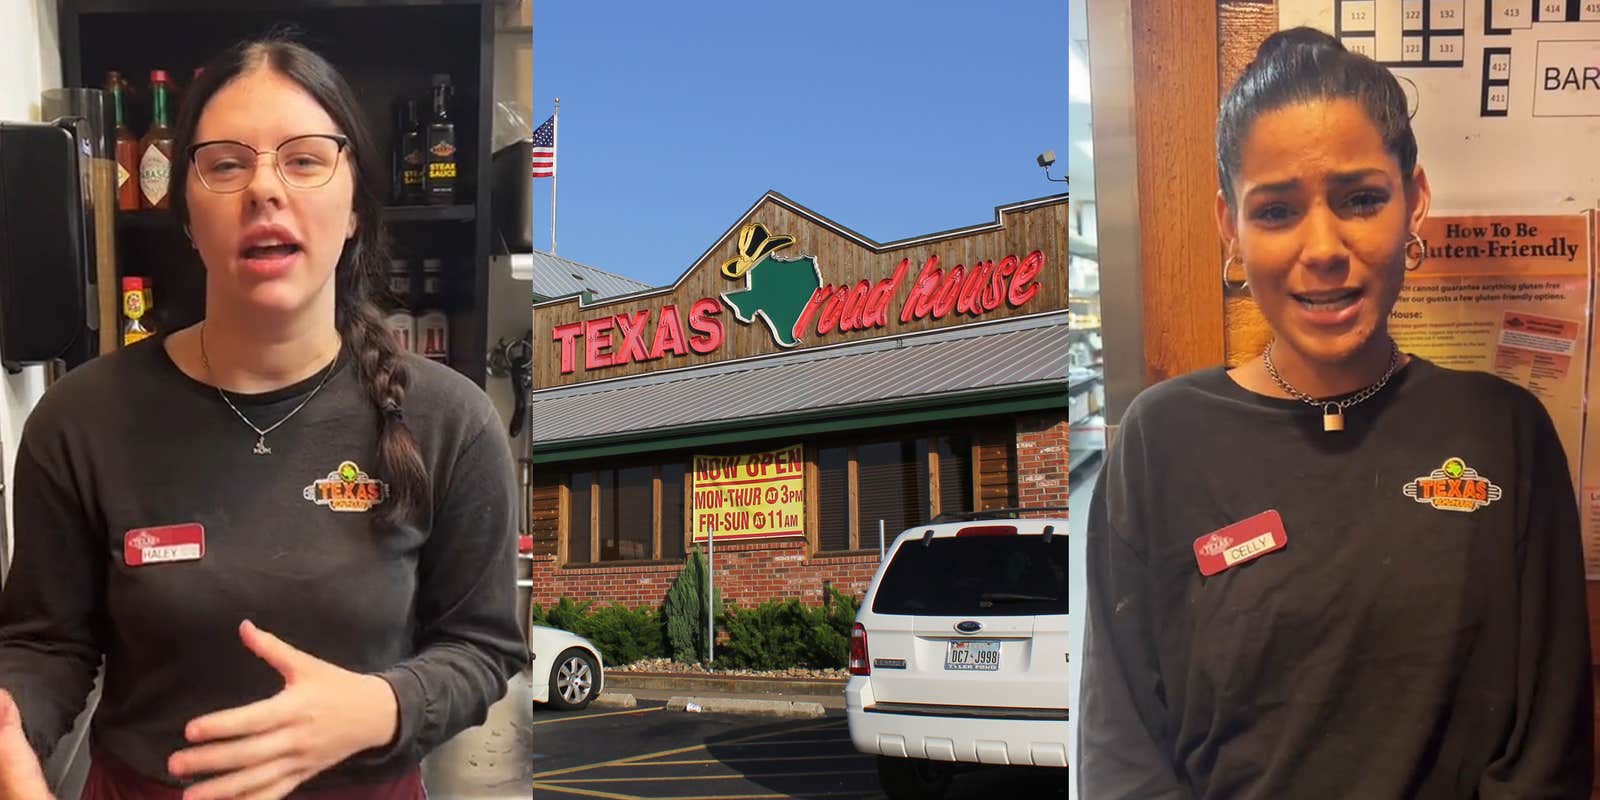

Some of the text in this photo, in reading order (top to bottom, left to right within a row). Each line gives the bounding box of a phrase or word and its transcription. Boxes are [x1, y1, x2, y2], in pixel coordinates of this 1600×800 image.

[1440, 10, 1455, 18] 132
[1504, 8, 1520, 17] 413
[1545, 5, 1560, 13] 414
[1351, 11, 1366, 20] 112
[1406, 11, 1420, 19] 122
[1405, 45, 1420, 53] 121
[1440, 44, 1454, 53] 131
[1492, 63, 1507, 72] 412
[1544, 67, 1600, 91] BAR
[1490, 94, 1505, 102] 411
[430, 170, 456, 178] SAUCE
[1446, 222, 1538, 239] How To Be
[1412, 284, 1439, 292] cannot
[1441, 283, 1481, 294] guarantee
[553, 250, 1045, 373] TEXAS road house
[696, 448, 802, 481] NOW OPEN
[319, 481, 380, 501] TEXAS
[1420, 479, 1488, 501] TEXAS
[695, 487, 762, 509] MON-THUR
[699, 511, 750, 532] FRI-SUN
[1231, 536, 1267, 560] CELLY
[144, 549, 177, 560] HALEY
